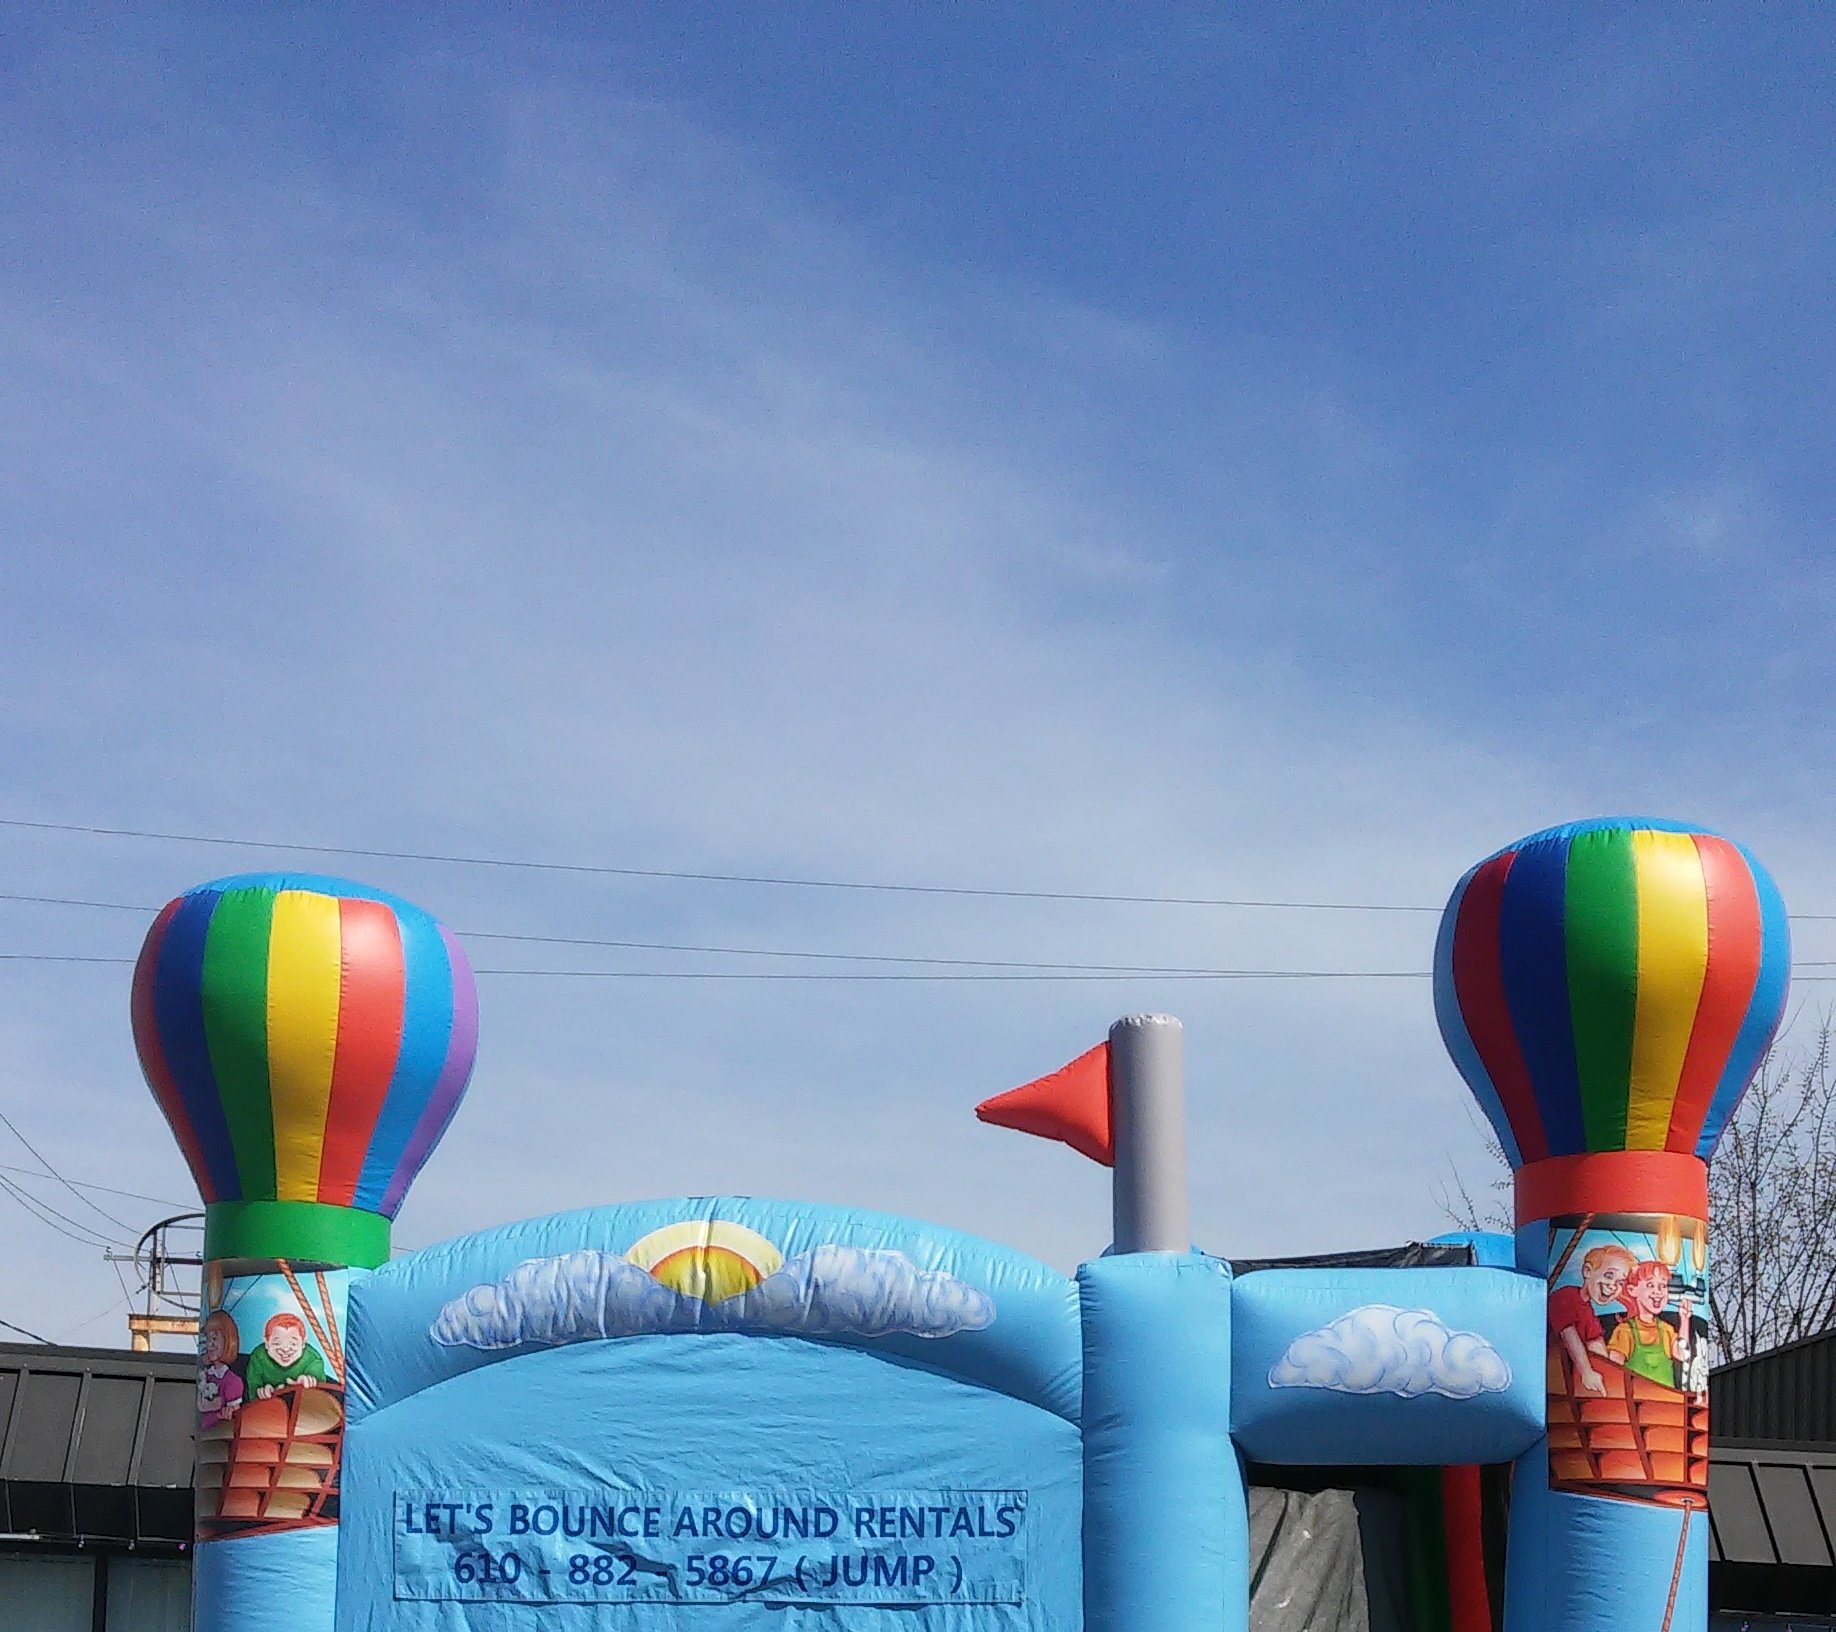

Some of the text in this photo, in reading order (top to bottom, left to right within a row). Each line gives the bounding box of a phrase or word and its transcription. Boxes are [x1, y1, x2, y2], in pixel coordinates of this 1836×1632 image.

[405, 1502, 1016, 1539] LET'S BOUNCE AROUND RENTALS
[454, 1552, 521, 1585] 610
[568, 1554, 638, 1587] 882
[686, 1555, 777, 1587] 5867
[822, 1555, 935, 1587] JUMP
